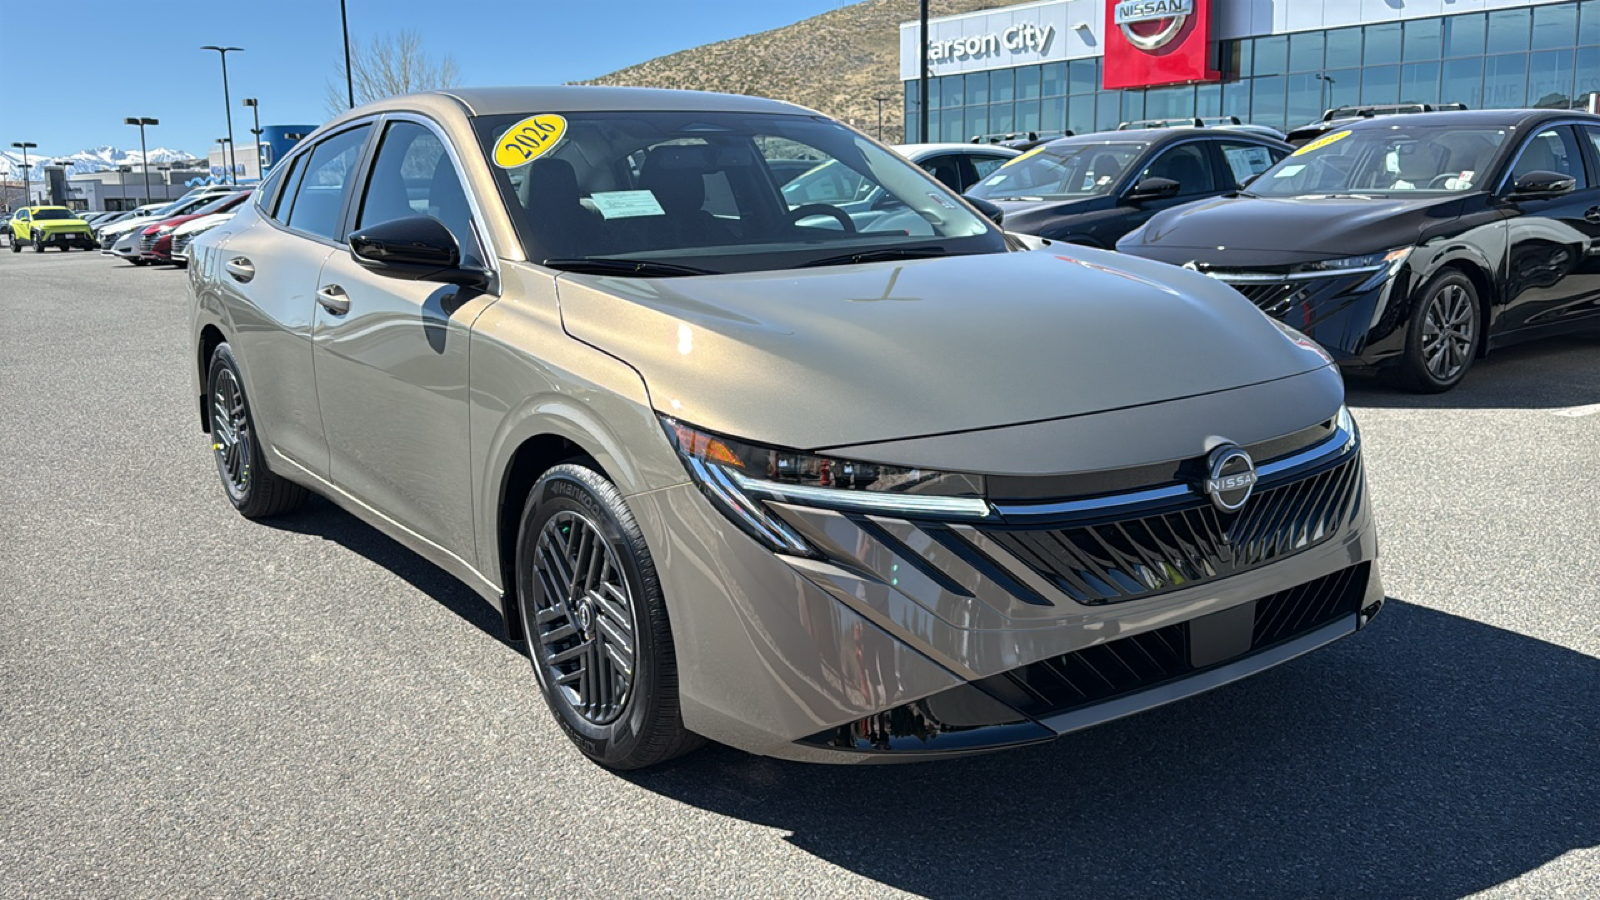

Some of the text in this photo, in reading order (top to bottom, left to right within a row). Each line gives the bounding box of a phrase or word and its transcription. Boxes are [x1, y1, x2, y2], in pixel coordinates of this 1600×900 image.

[1119, 0, 1182, 19] NISSAN
[1003, 23, 1052, 52] City
[505, 119, 556, 159] 2026
[1209, 473, 1258, 491] NISSAN
